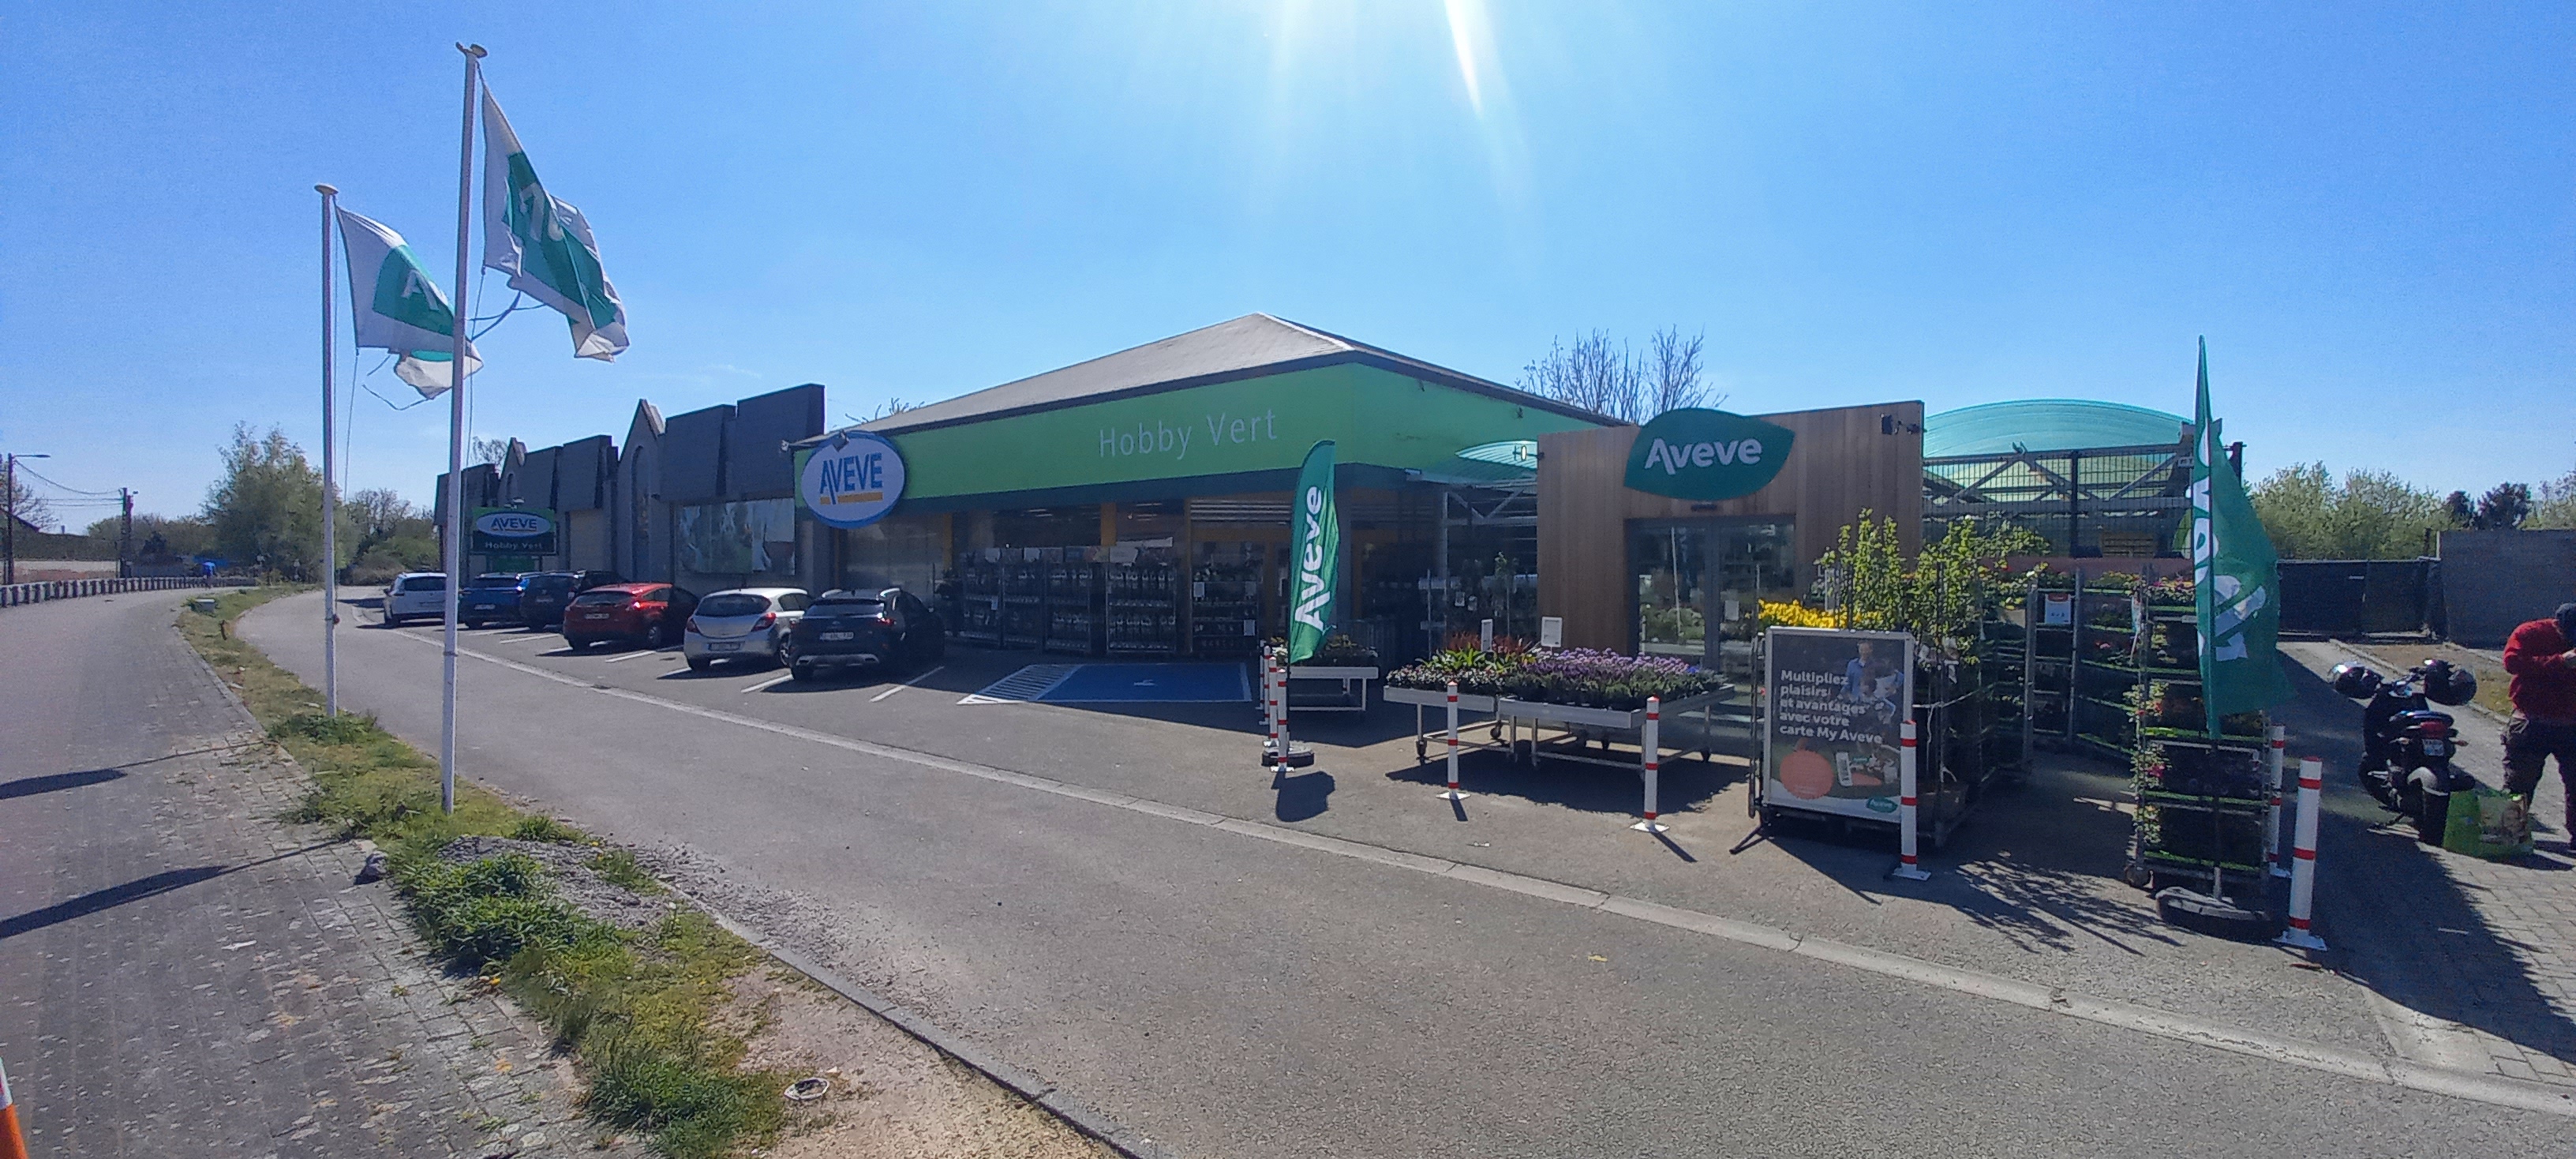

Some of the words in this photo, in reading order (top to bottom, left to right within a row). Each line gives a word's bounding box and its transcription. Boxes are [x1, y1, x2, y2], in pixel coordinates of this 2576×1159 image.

[1099, 420, 1192, 460] Hobby
[1206, 409, 1277, 446] Vert
[1644, 438, 1762, 475] Aveve
[820, 452, 883, 505] AVEVE
[490, 517, 537, 531] AVEVE
[1294, 486, 1331, 632] Aveve
[1780, 670, 1848, 685] Multipliez
[1779, 697, 1794, 708] et
[1795, 699, 1866, 716] avantages
[1779, 711, 1810, 722] avec
[1812, 714, 1849, 726] votre
[1779, 724, 1814, 737] carte
[1817, 726, 1837, 741] My
[1839, 729, 1882, 744] Aveve
